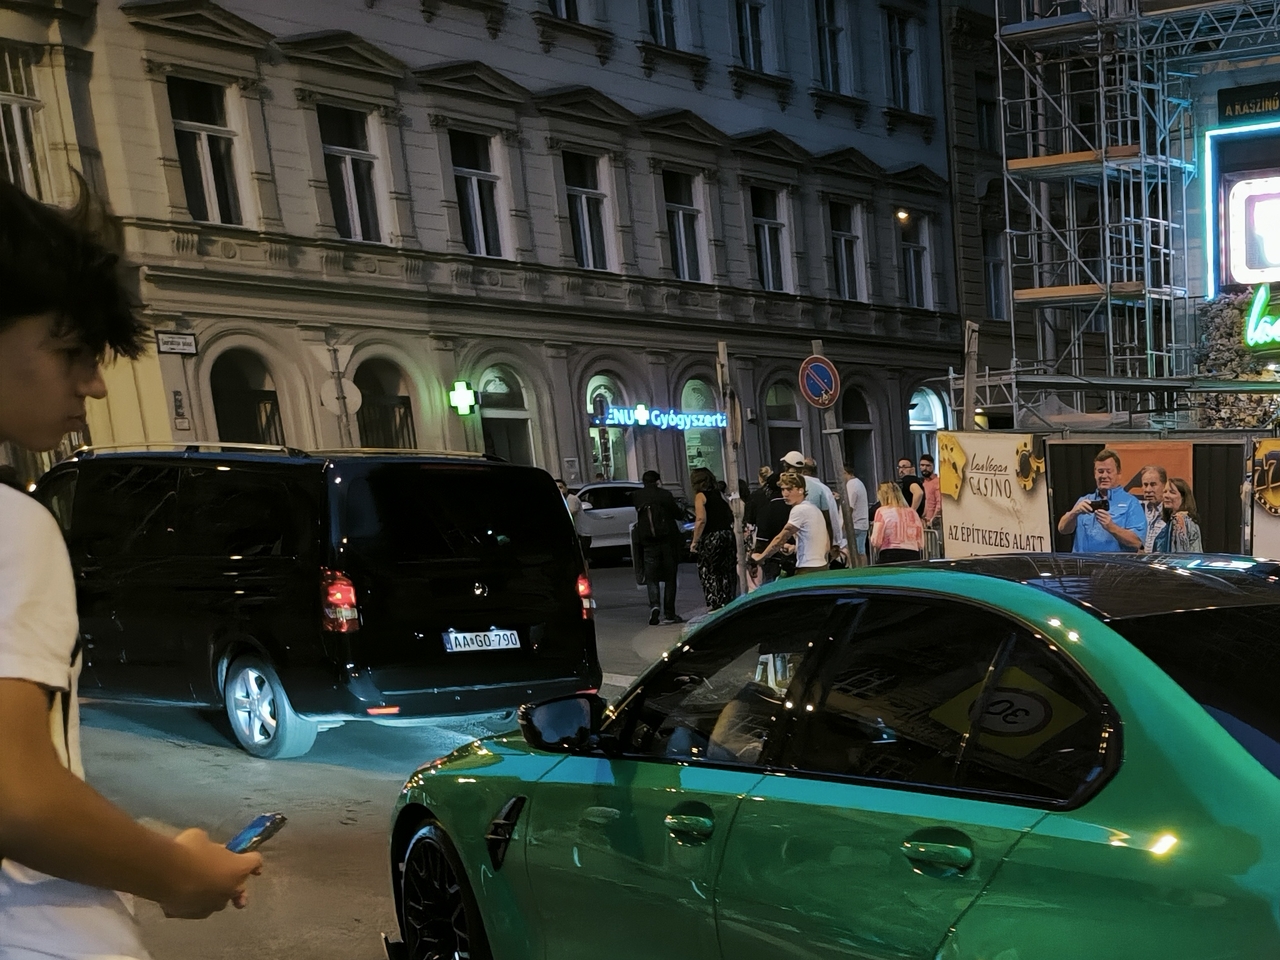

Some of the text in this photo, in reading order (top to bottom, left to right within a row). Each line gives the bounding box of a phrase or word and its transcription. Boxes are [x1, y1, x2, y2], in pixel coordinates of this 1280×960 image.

[969, 476, 1012, 499] CASINO
[948, 522, 1045, 552] AZ ÉPÍTKEZÉS ALATT
[454, 635, 471, 649] AA
